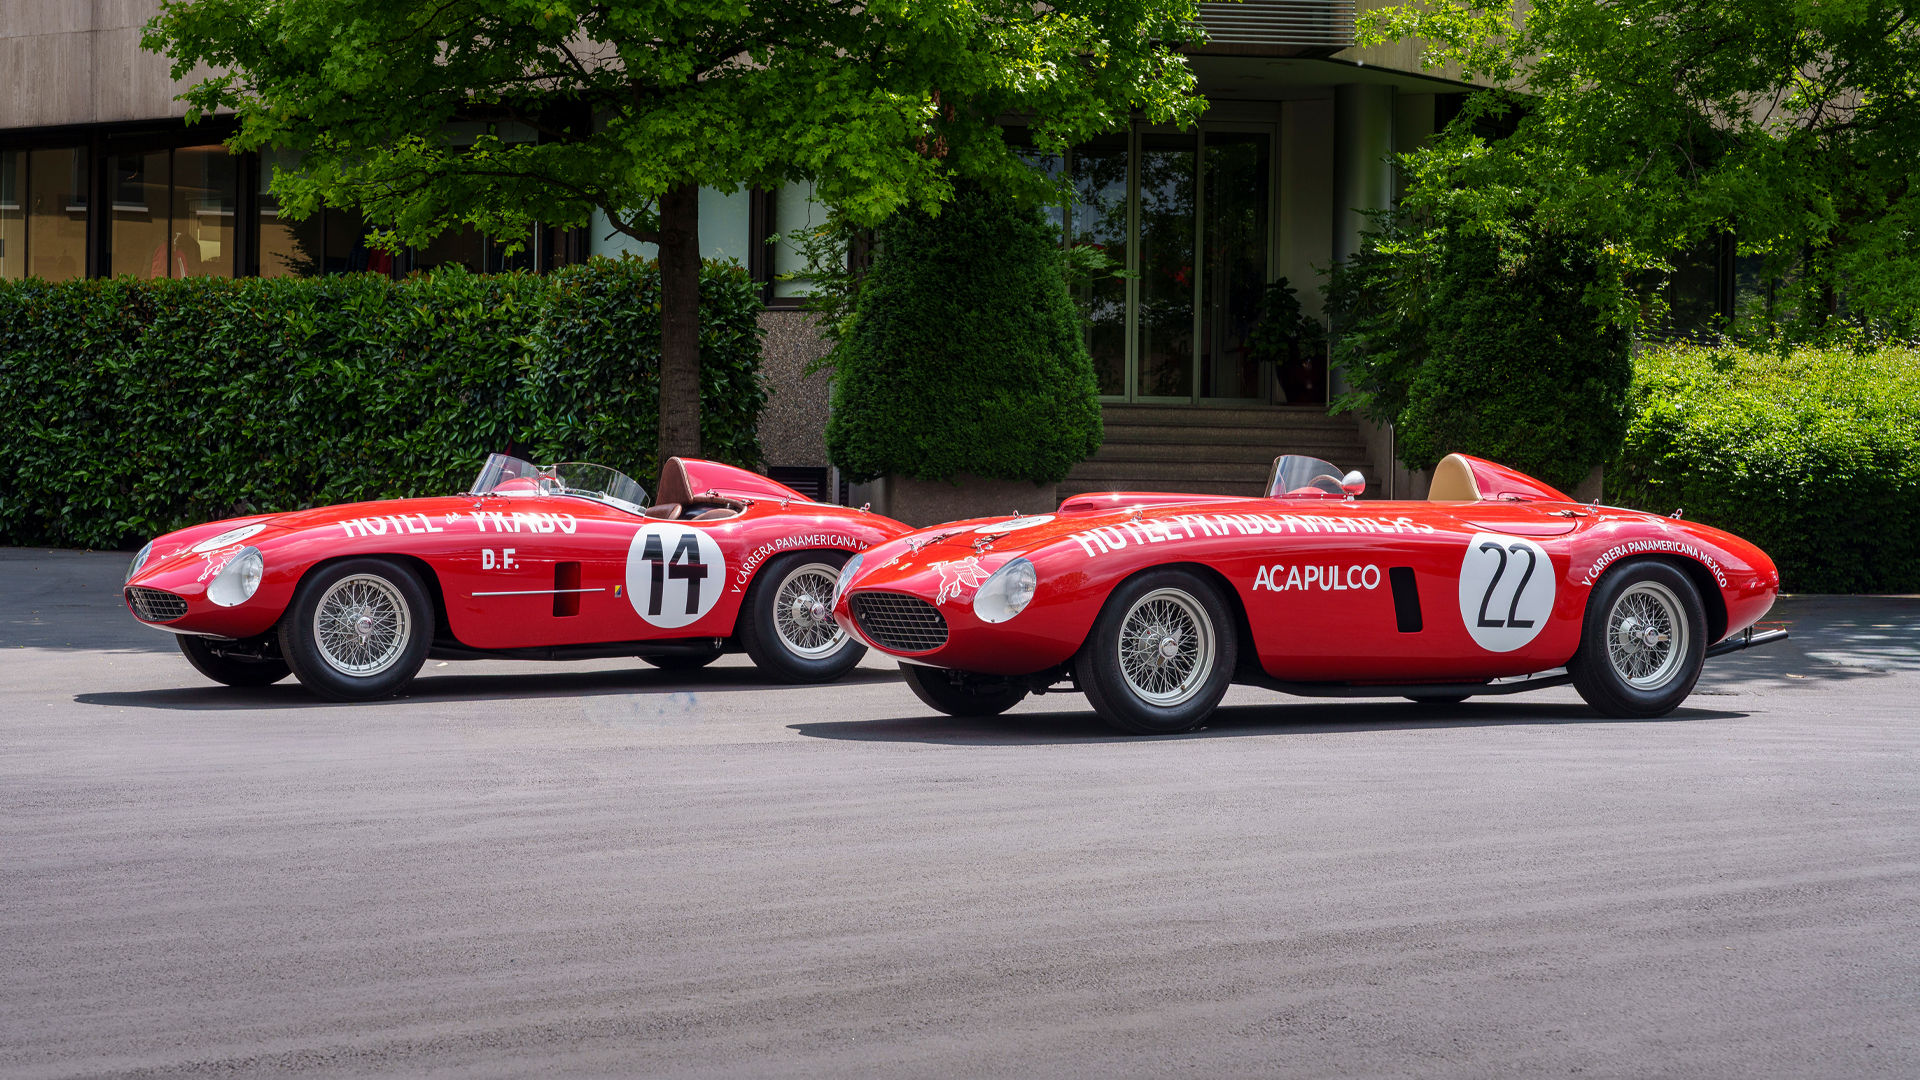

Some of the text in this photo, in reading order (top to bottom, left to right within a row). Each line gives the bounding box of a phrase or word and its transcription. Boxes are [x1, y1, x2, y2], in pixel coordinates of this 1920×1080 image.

[481, 548, 520, 570] D.F.
[775, 534, 857, 550] PANAMERICANA
[641, 533, 708, 616] 14
[736, 543, 776, 586] CARRERA
[1252, 564, 1381, 592] ACAPULCO
[1581, 540, 1728, 588] V CARRERA PANAMERICANA MEXICO
[731, 586, 742, 594] V
[1476, 541, 1537, 629] 22
